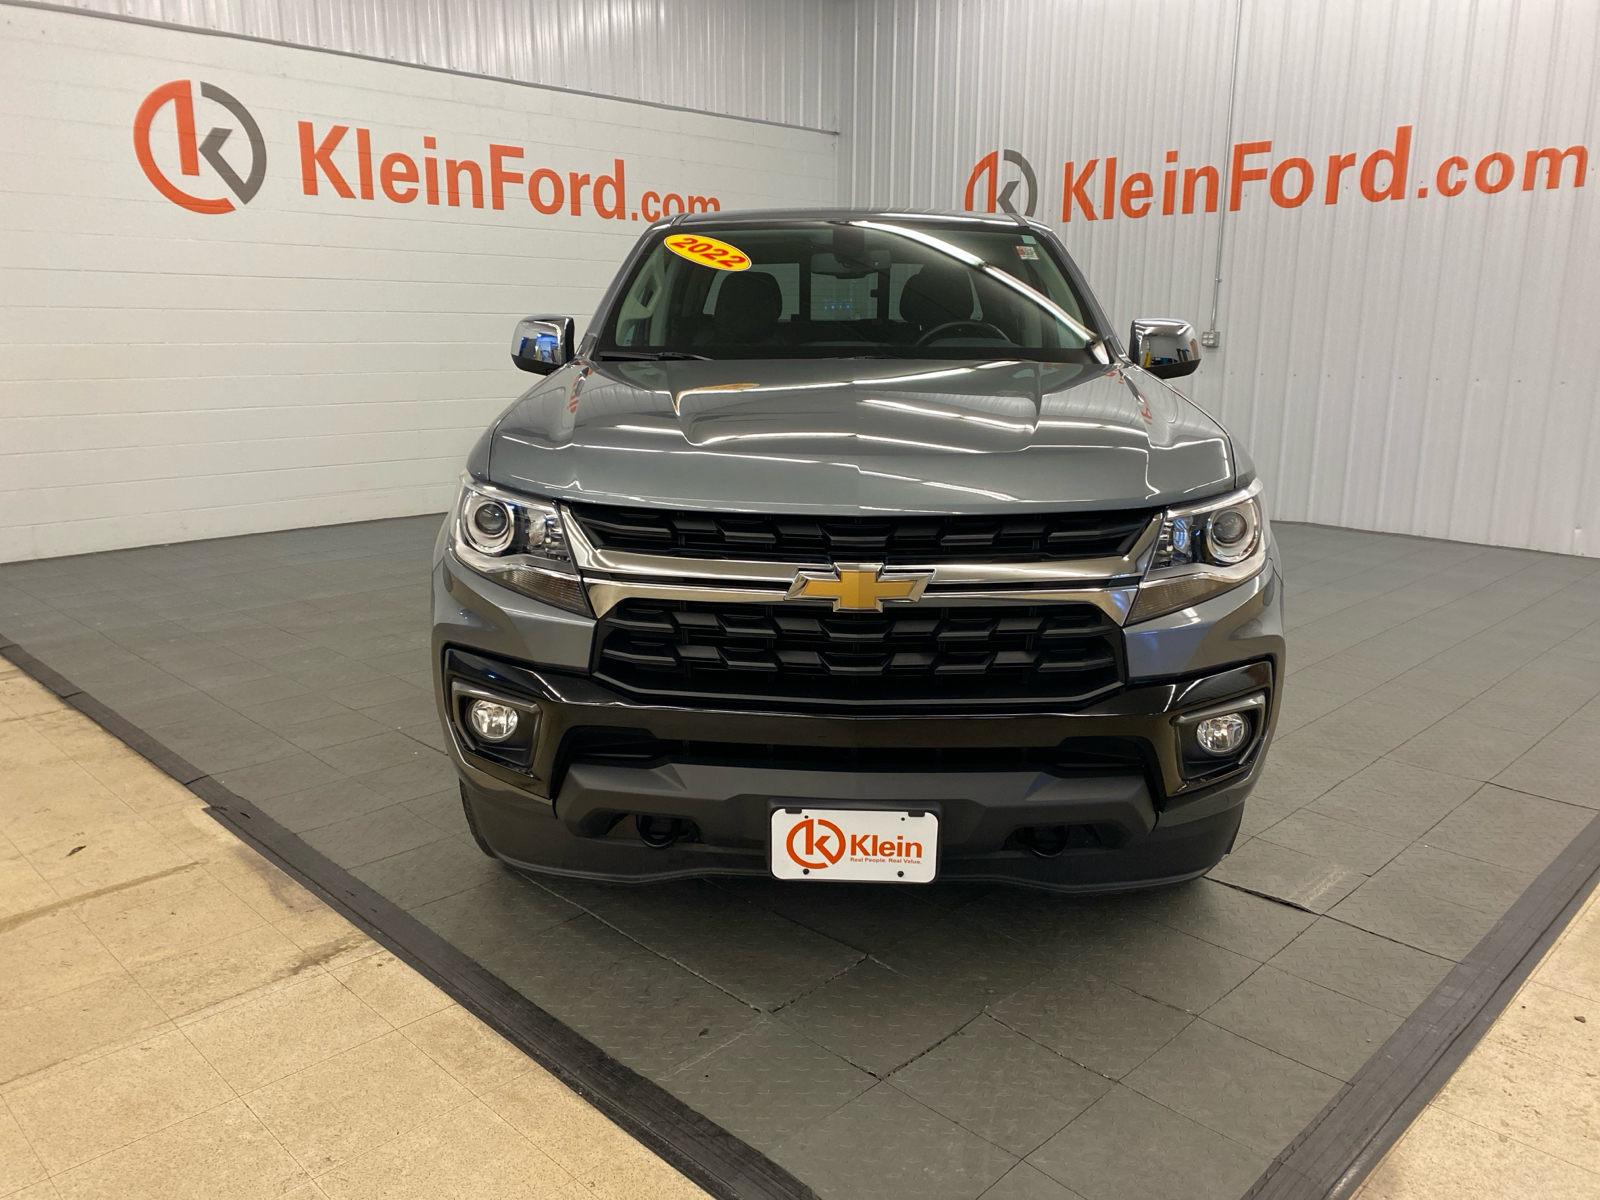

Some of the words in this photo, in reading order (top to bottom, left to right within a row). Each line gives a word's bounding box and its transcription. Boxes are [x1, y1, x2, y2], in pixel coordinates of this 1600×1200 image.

[298, 121, 720, 223] KleinFord.com
[1061, 125, 1588, 223] KleinFord.com
[669, 237, 747, 268] 2022
[850, 834, 922, 858] Klein
